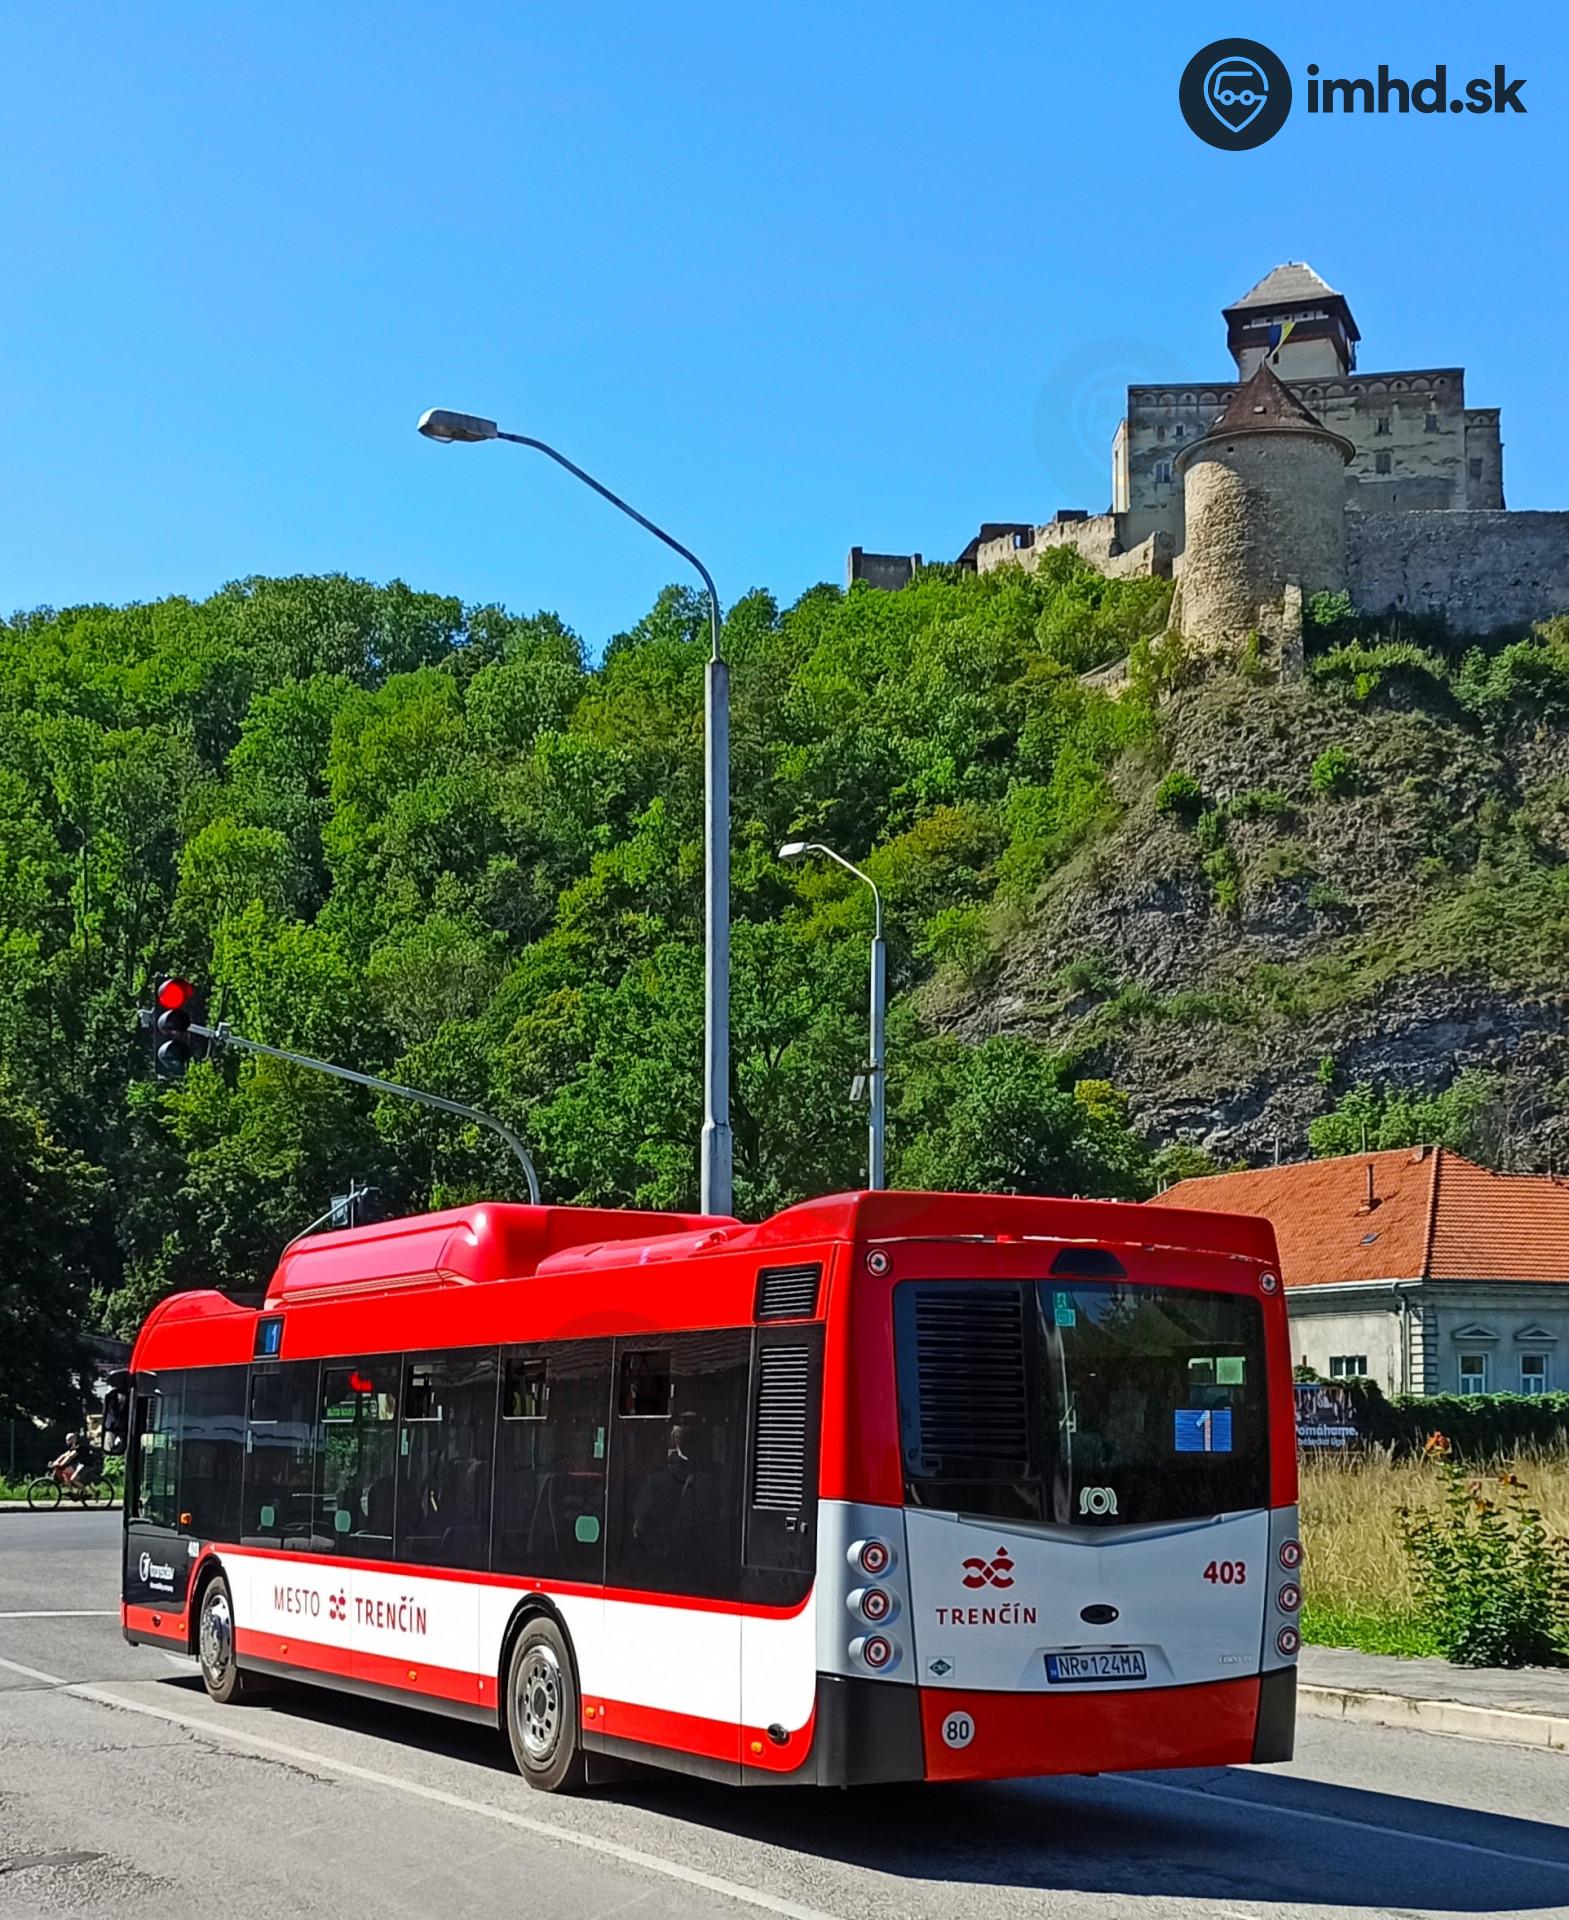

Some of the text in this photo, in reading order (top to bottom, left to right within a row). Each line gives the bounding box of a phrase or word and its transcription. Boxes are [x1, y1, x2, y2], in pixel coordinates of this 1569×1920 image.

[1196, 1410, 1211, 1452] 1
[1203, 1561, 1246, 1585] 403
[274, 1585, 427, 1635] MESTO TRENČÍN
[935, 1603, 1037, 1625] TRENČÍN
[1058, 1655, 1143, 1677] NR 124MA
[947, 1720, 970, 1741] 80
